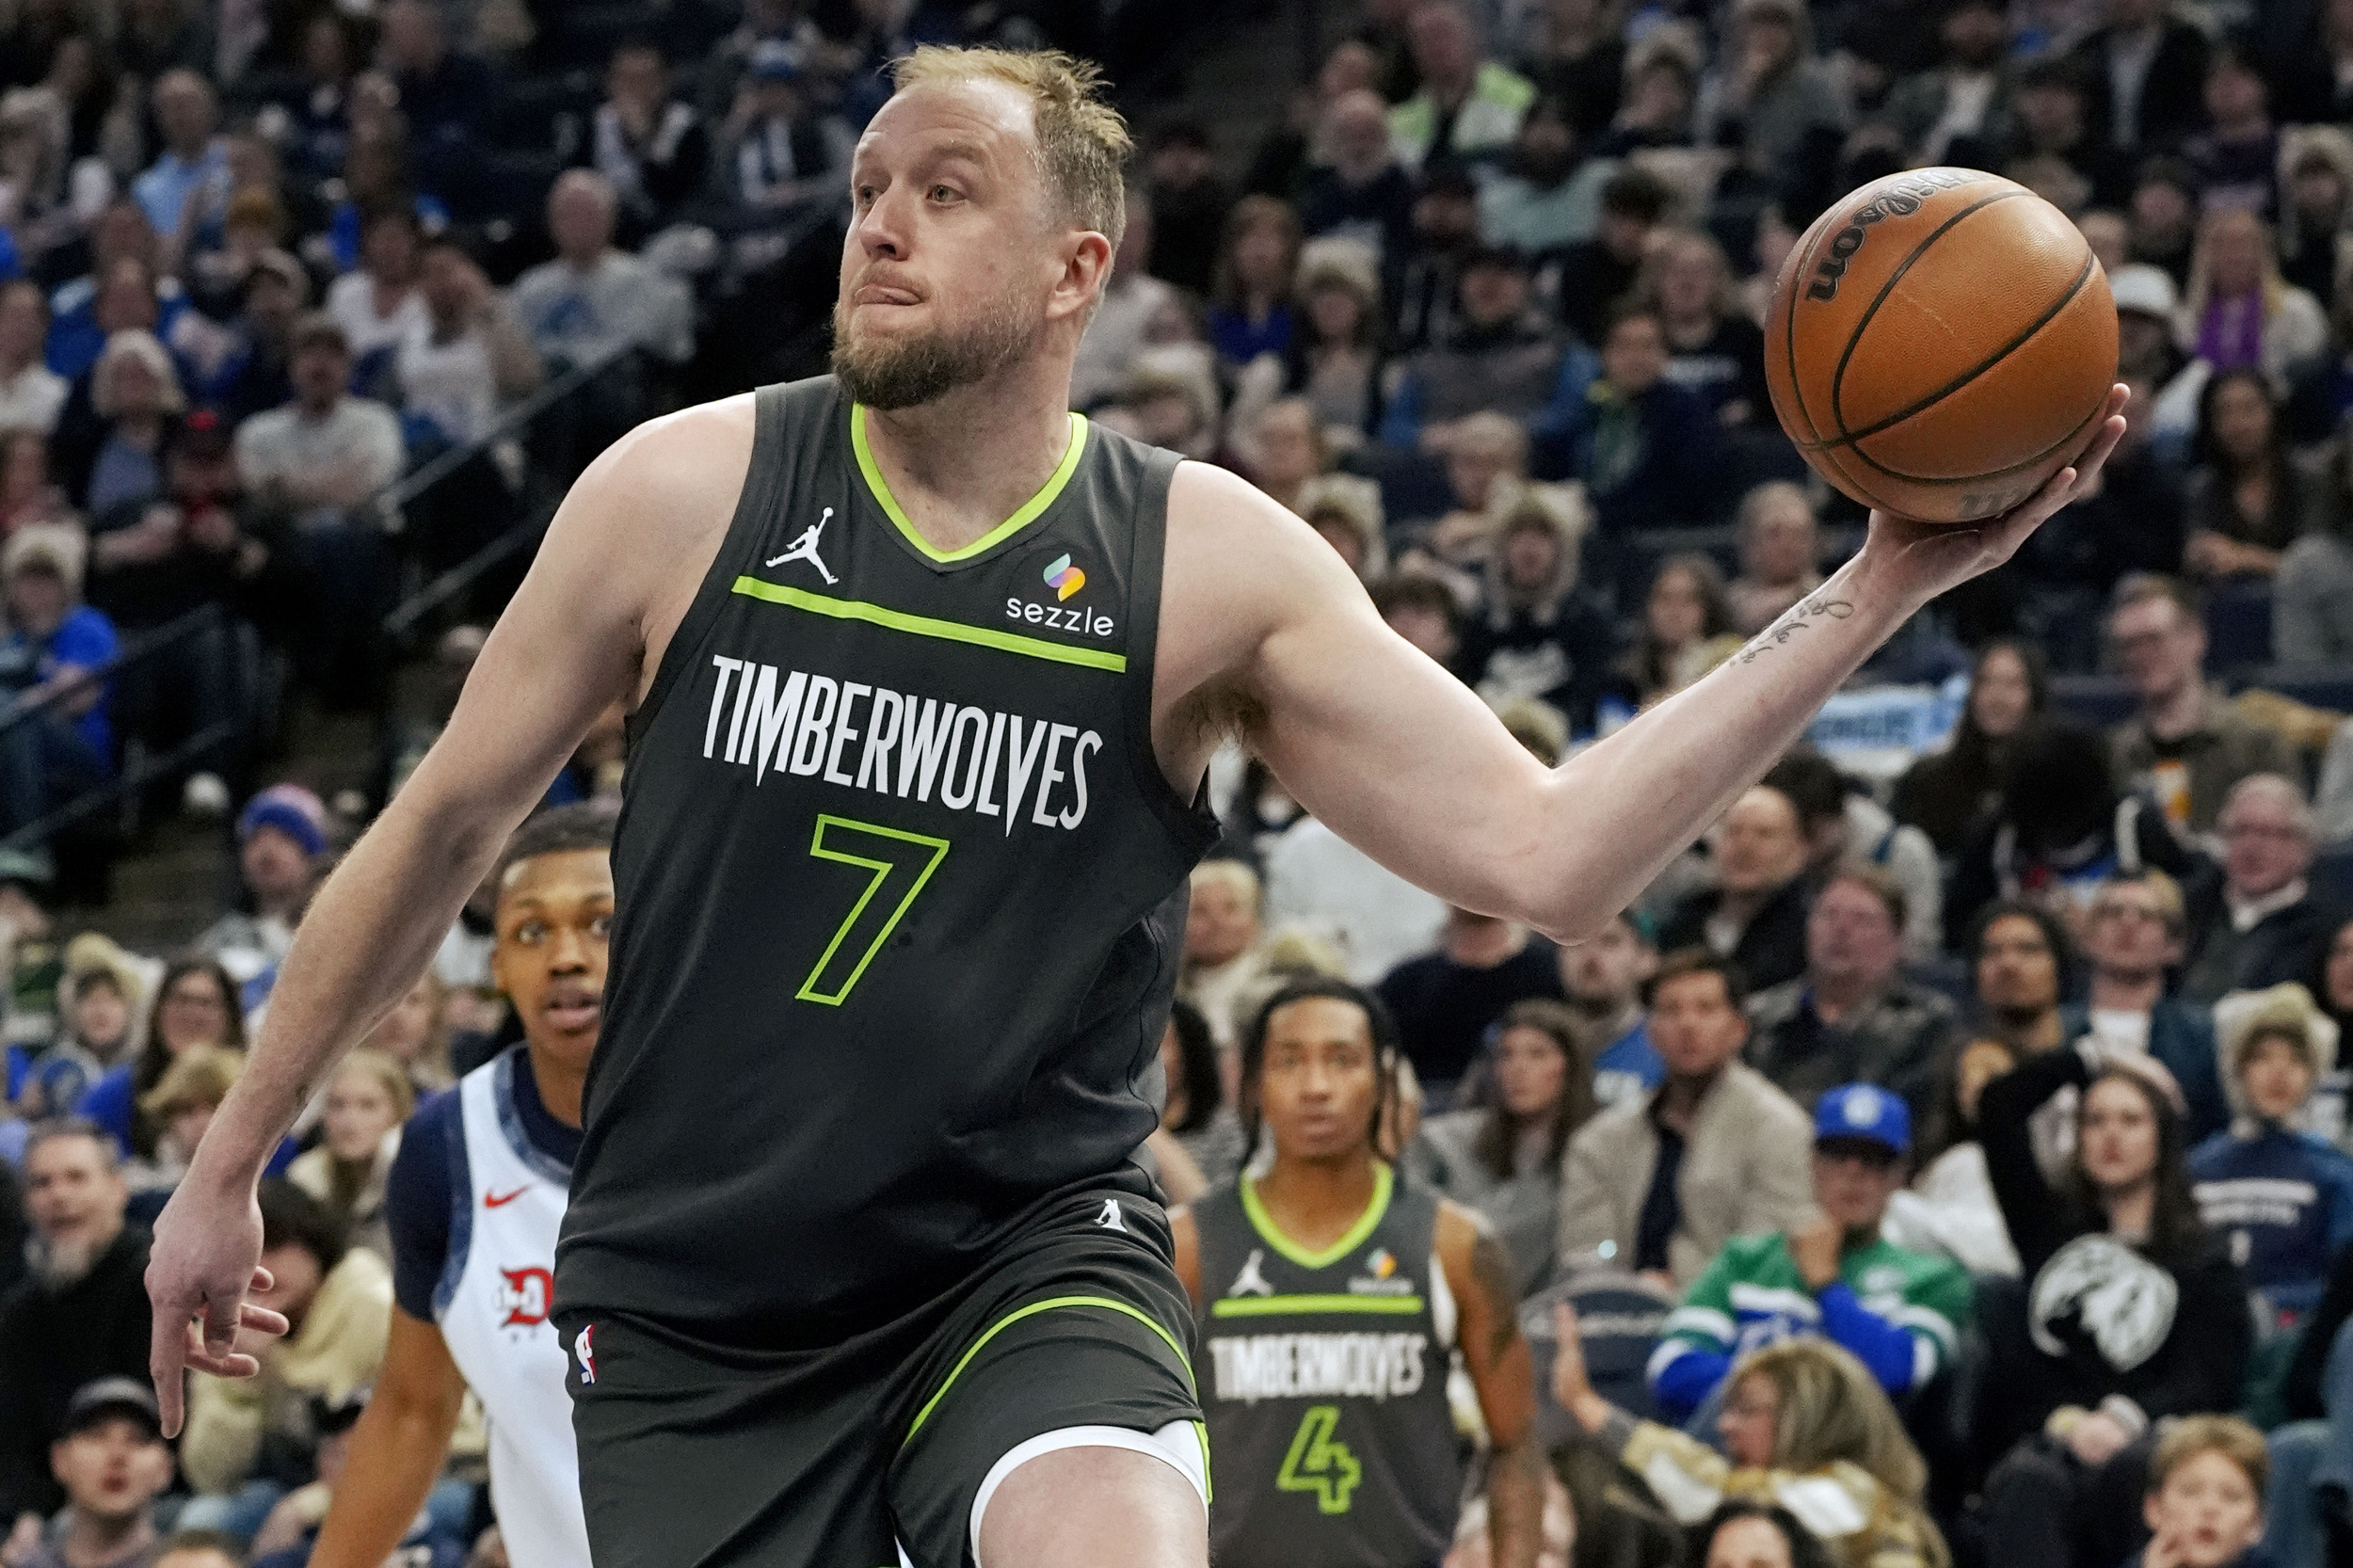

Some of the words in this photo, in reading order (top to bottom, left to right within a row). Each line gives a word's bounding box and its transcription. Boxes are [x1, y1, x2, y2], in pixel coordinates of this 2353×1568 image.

[1005, 597, 1115, 636] sezzle
[703, 654, 1104, 838] TIMBERWOLVES
[794, 813, 951, 1006] 7
[1276, 1404, 1362, 1514] 4
